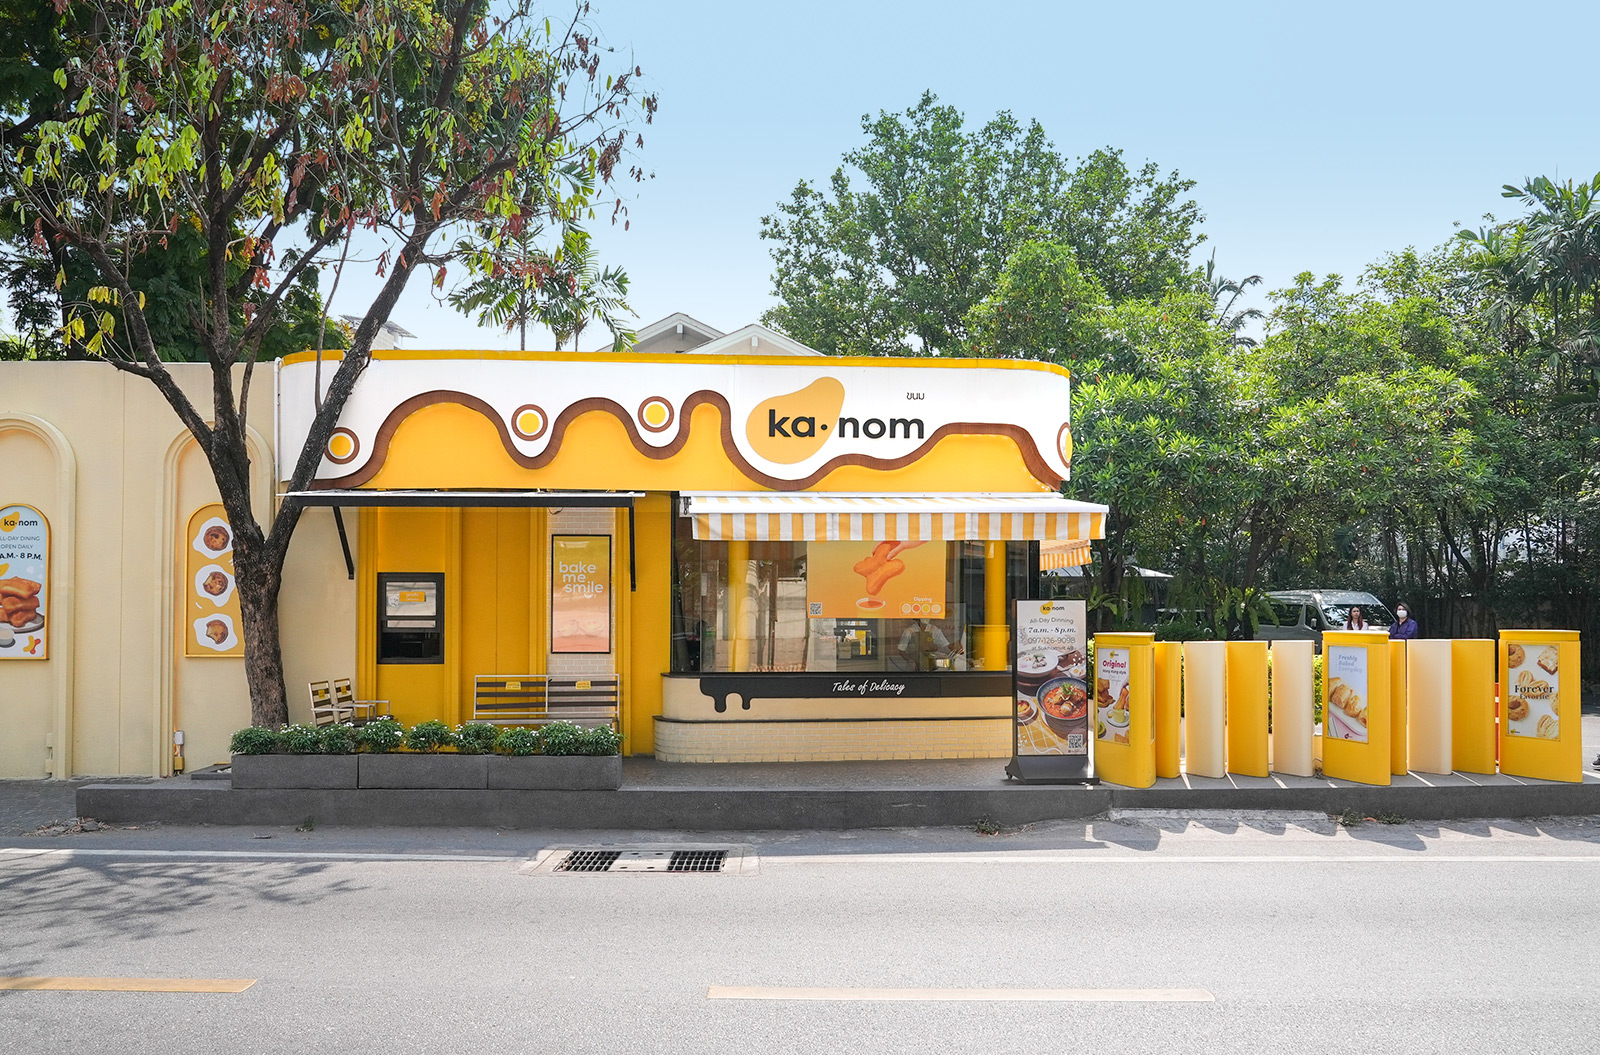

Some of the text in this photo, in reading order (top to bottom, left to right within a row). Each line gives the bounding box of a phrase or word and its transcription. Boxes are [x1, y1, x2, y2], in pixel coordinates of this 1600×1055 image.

[27, 553, 43, 561] P.M.
[559, 561, 597, 574] bake
[563, 574, 586, 583] me
[565, 581, 604, 593] smile
[1338, 654, 1358, 662] Freshly
[1102, 659, 1127, 669] Original
[832, 679, 906, 695] Tales of Delicacy
[1514, 684, 1554, 693] Forever
